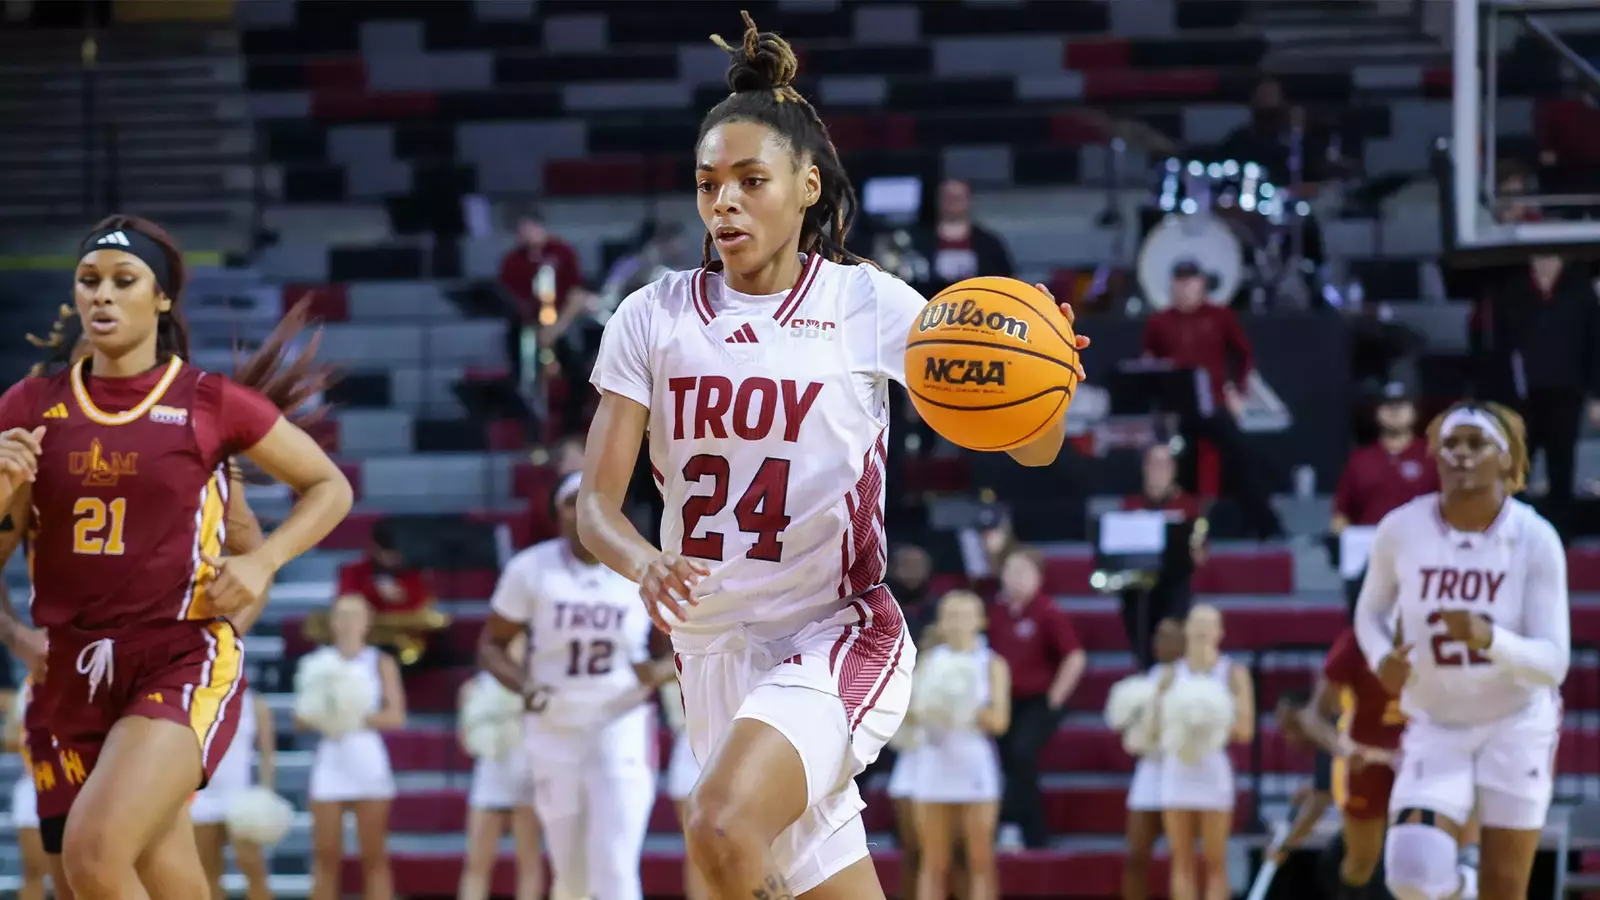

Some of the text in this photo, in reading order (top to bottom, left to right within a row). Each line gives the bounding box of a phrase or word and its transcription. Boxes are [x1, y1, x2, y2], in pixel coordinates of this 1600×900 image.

[919, 299, 1029, 343] Wilson
[924, 356, 1006, 386] NCAA
[669, 376, 824, 442] TROY
[73, 497, 127, 555] 21
[681, 454, 791, 562] 24
[1419, 568, 1505, 602] TROY
[555, 602, 628, 630] TROY
[566, 638, 614, 677] 12
